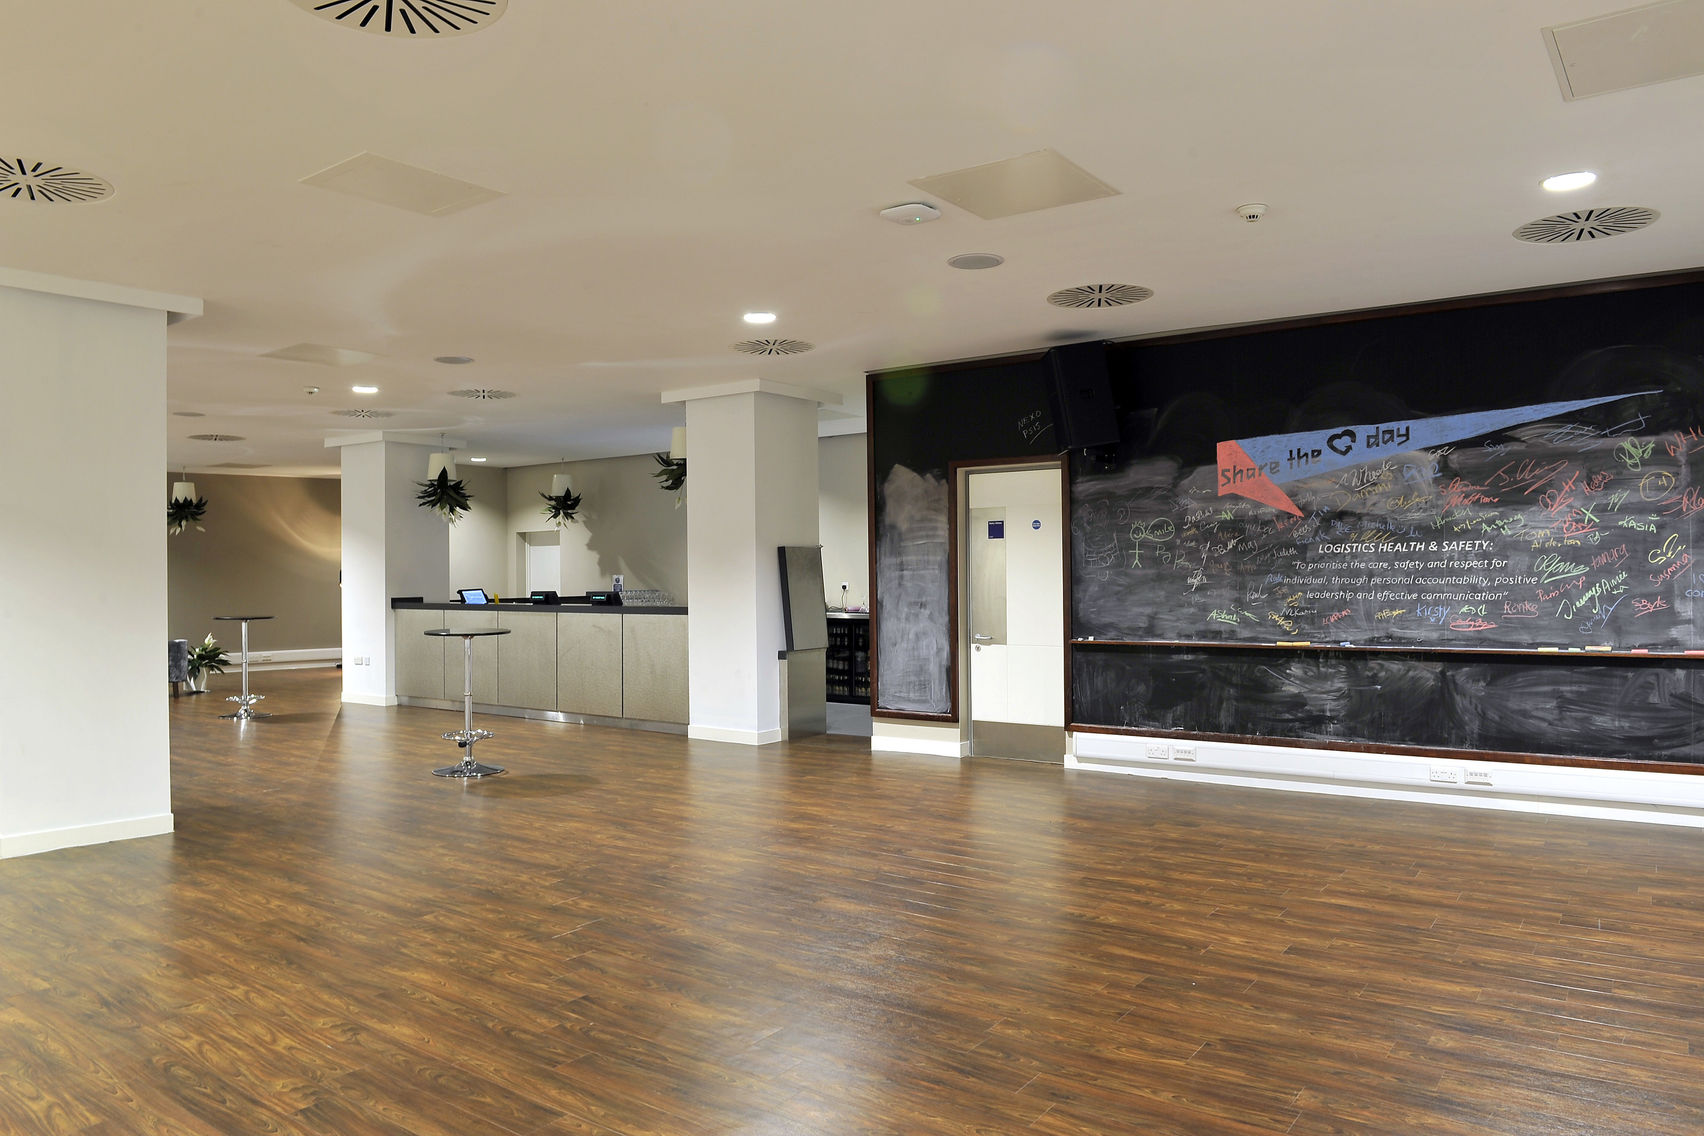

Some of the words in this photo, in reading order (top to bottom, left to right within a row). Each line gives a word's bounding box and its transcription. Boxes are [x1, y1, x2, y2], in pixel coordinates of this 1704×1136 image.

[1220, 461, 1281, 487] share
[1286, 447, 1322, 470] the
[1366, 426, 1411, 449] day
[1318, 542, 1375, 553] LOGISTICS
[1378, 541, 1425, 553] HEALTH
[1428, 540, 1438, 551] &
[1441, 540, 1494, 552] SAFETY:
[1307, 560, 1348, 571] prioritise
[1350, 560, 1365, 569] the
[1367, 561, 1391, 570] care,
[1393, 559, 1424, 570] safety
[1427, 559, 1447, 569] and
[1449, 559, 1489, 569] respect
[1489, 558, 1508, 569] for
[1283, 575, 1329, 585] individual,
[1331, 575, 1369, 585] through
[1370, 575, 1414, 586] personal
[1415, 574, 1491, 586] accountability,
[1494, 574, 1538, 586] positive
[1306, 590, 1354, 601] leadership
[1356, 590, 1375, 600] and
[1377, 590, 1418, 601] effective
